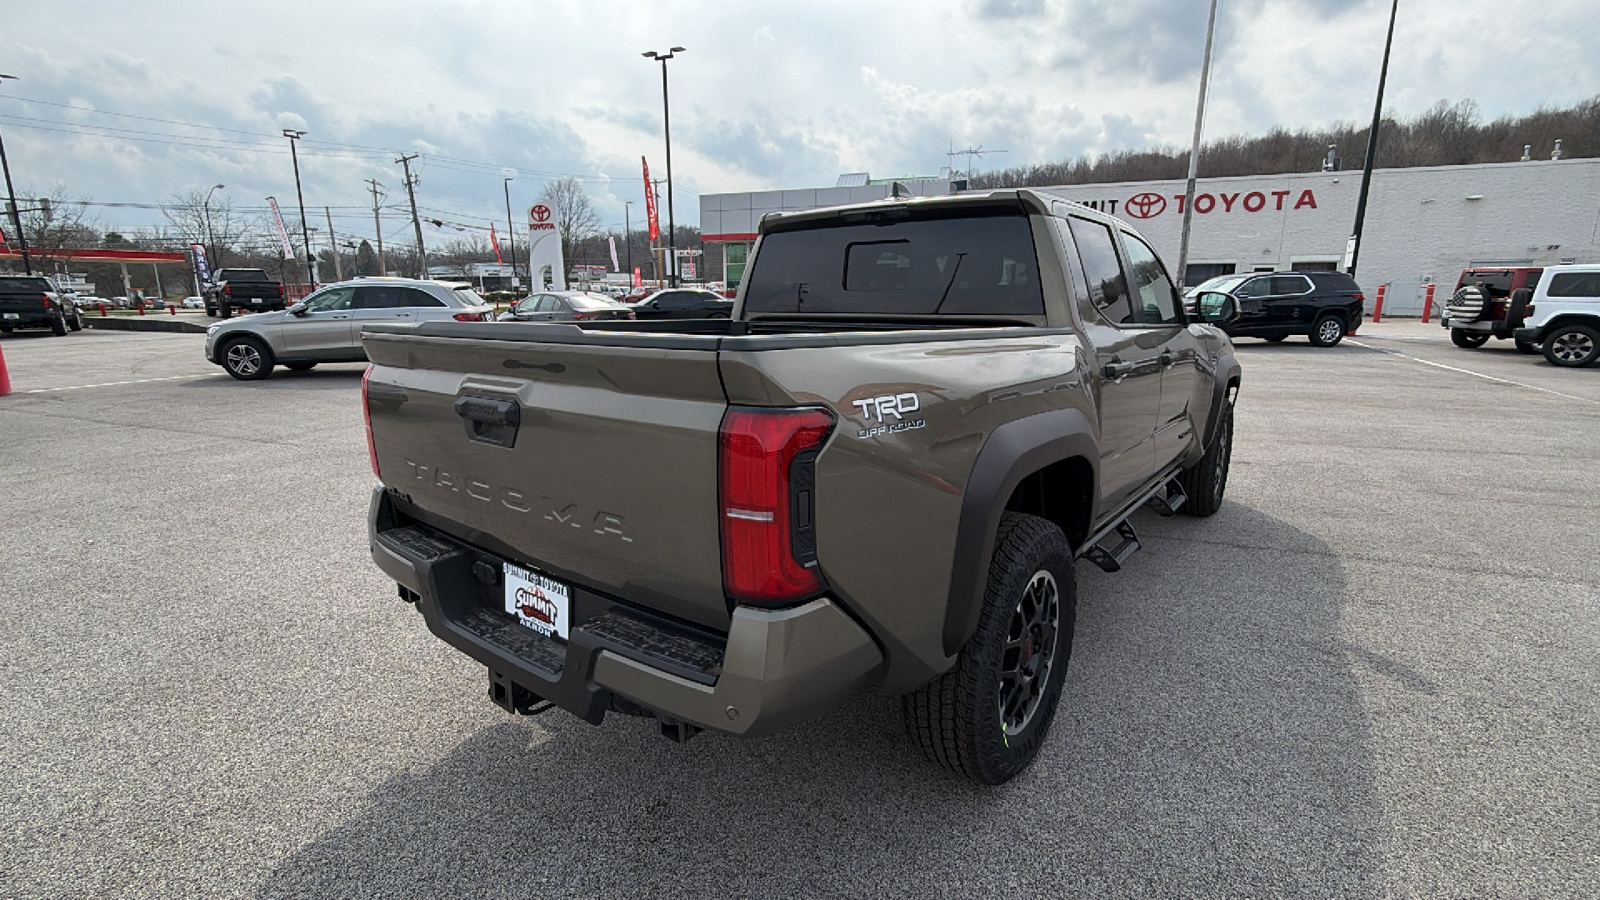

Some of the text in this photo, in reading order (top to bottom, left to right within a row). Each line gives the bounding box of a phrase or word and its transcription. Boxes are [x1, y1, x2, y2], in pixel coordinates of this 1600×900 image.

[1075, 189, 1317, 214] MIT TOYOTA
[529, 222, 556, 231] TOYOTA
[852, 392, 919, 423] TRD
[406, 459, 633, 543] TACOMA
[503, 562, 568, 597] SUMMIT TOYOTA
[516, 588, 557, 625] SUMMIT
